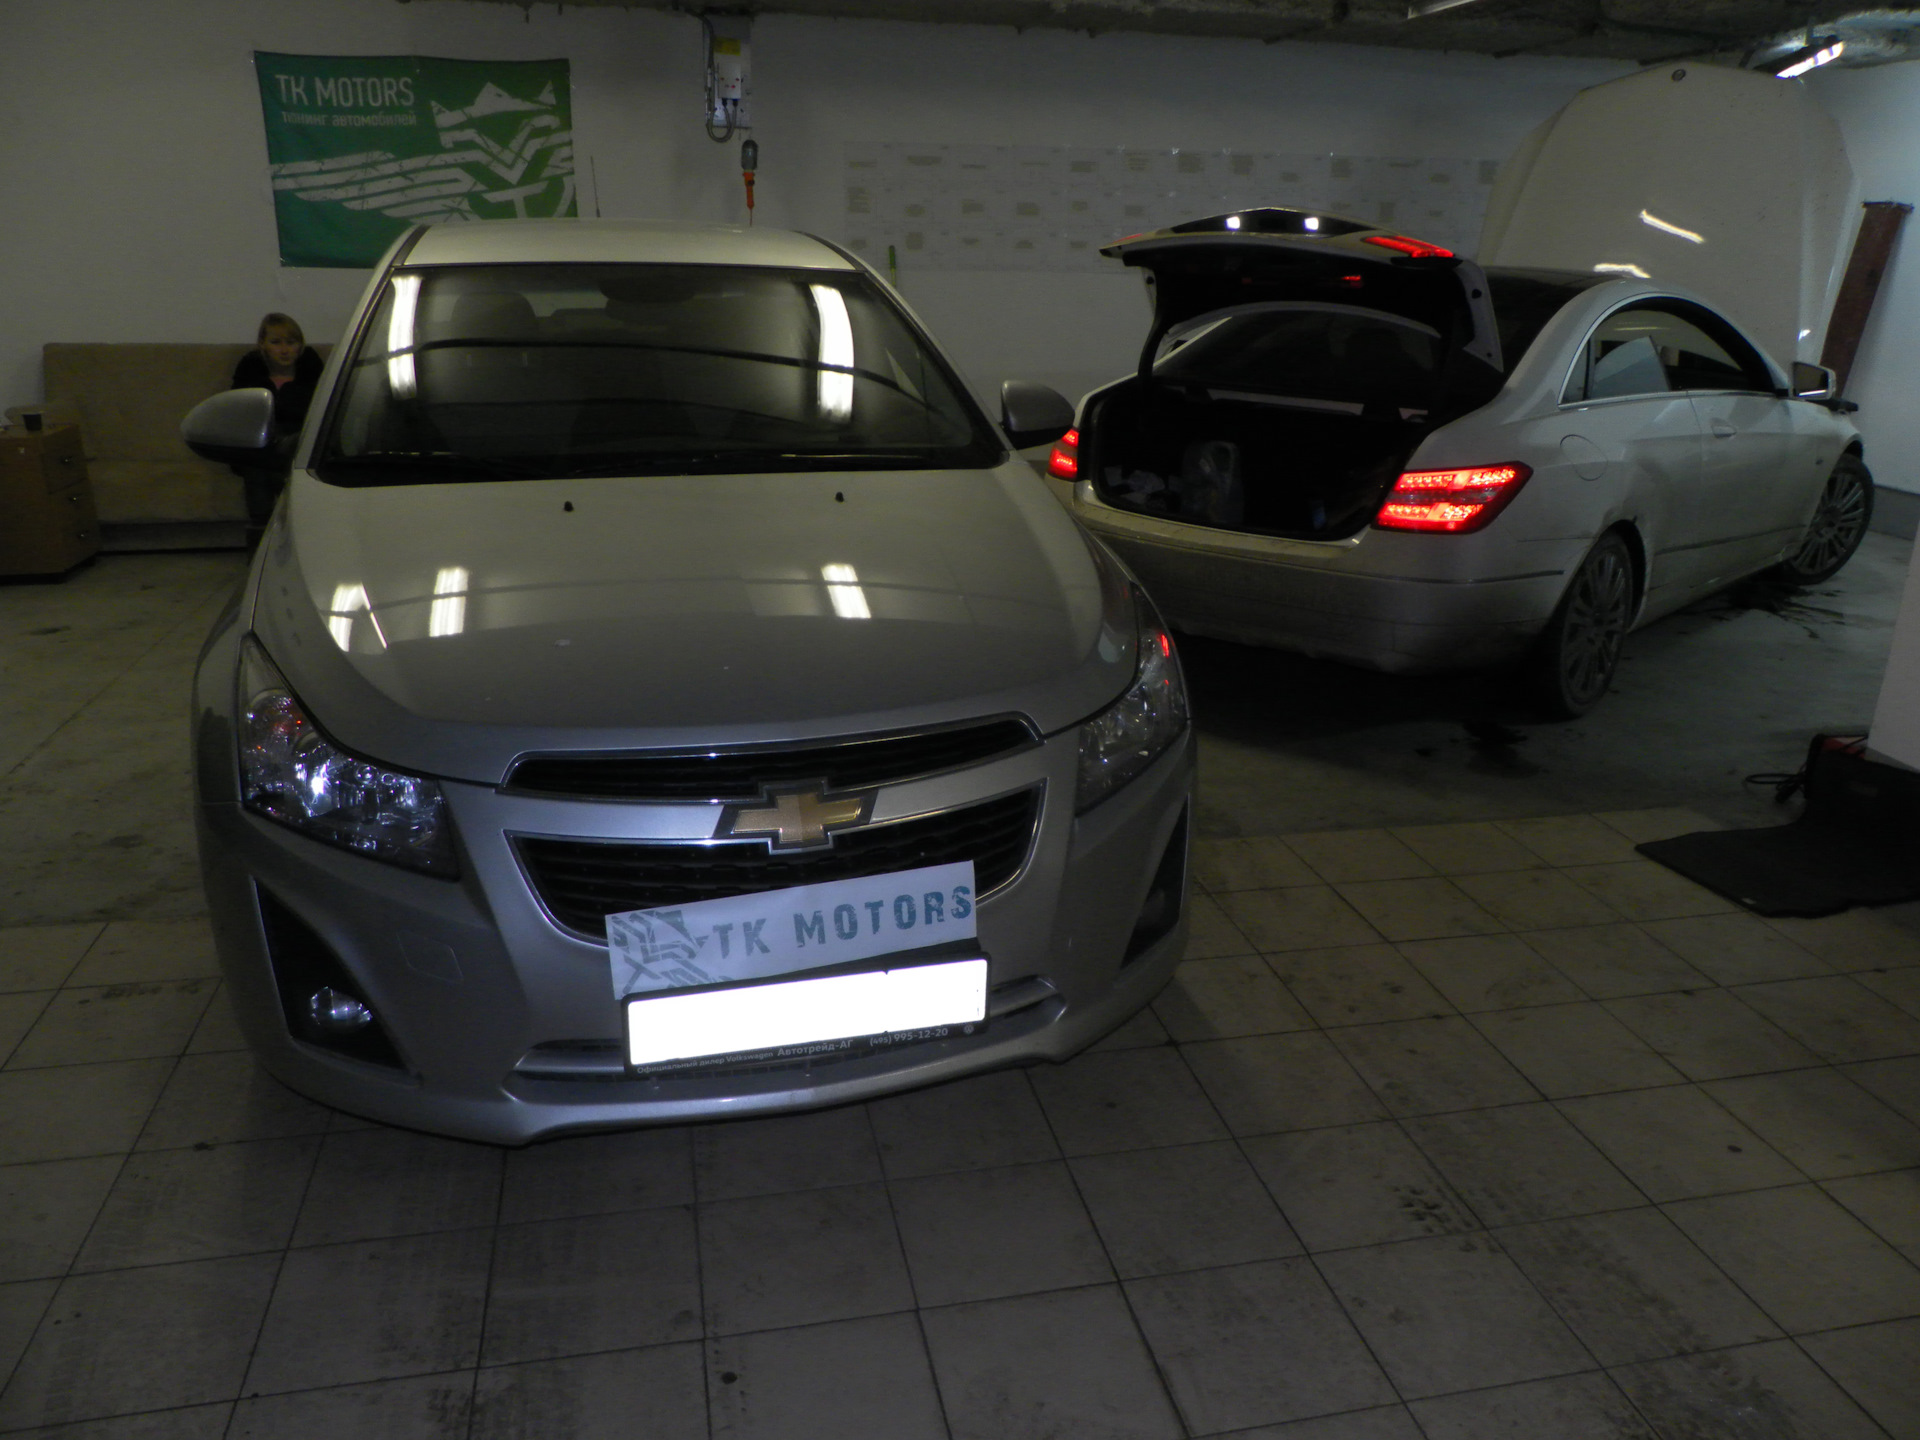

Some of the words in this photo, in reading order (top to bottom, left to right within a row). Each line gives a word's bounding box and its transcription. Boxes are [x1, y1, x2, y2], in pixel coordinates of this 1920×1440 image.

[275, 75, 309, 106] TK
[315, 77, 415, 107] MOTORS
[713, 918, 770, 959] TK
[794, 886, 972, 948] MOTORS
[637, 1060, 698, 1074] Официальный
[699, 1056, 724, 1067] дилер
[725, 1050, 773, 1064] Volkswagen
[777, 1039, 853, 1057] Автотрейд-АГ
[870, 1035, 892, 1048] (495)
[894, 1028, 948, 1042] 995-12-20
